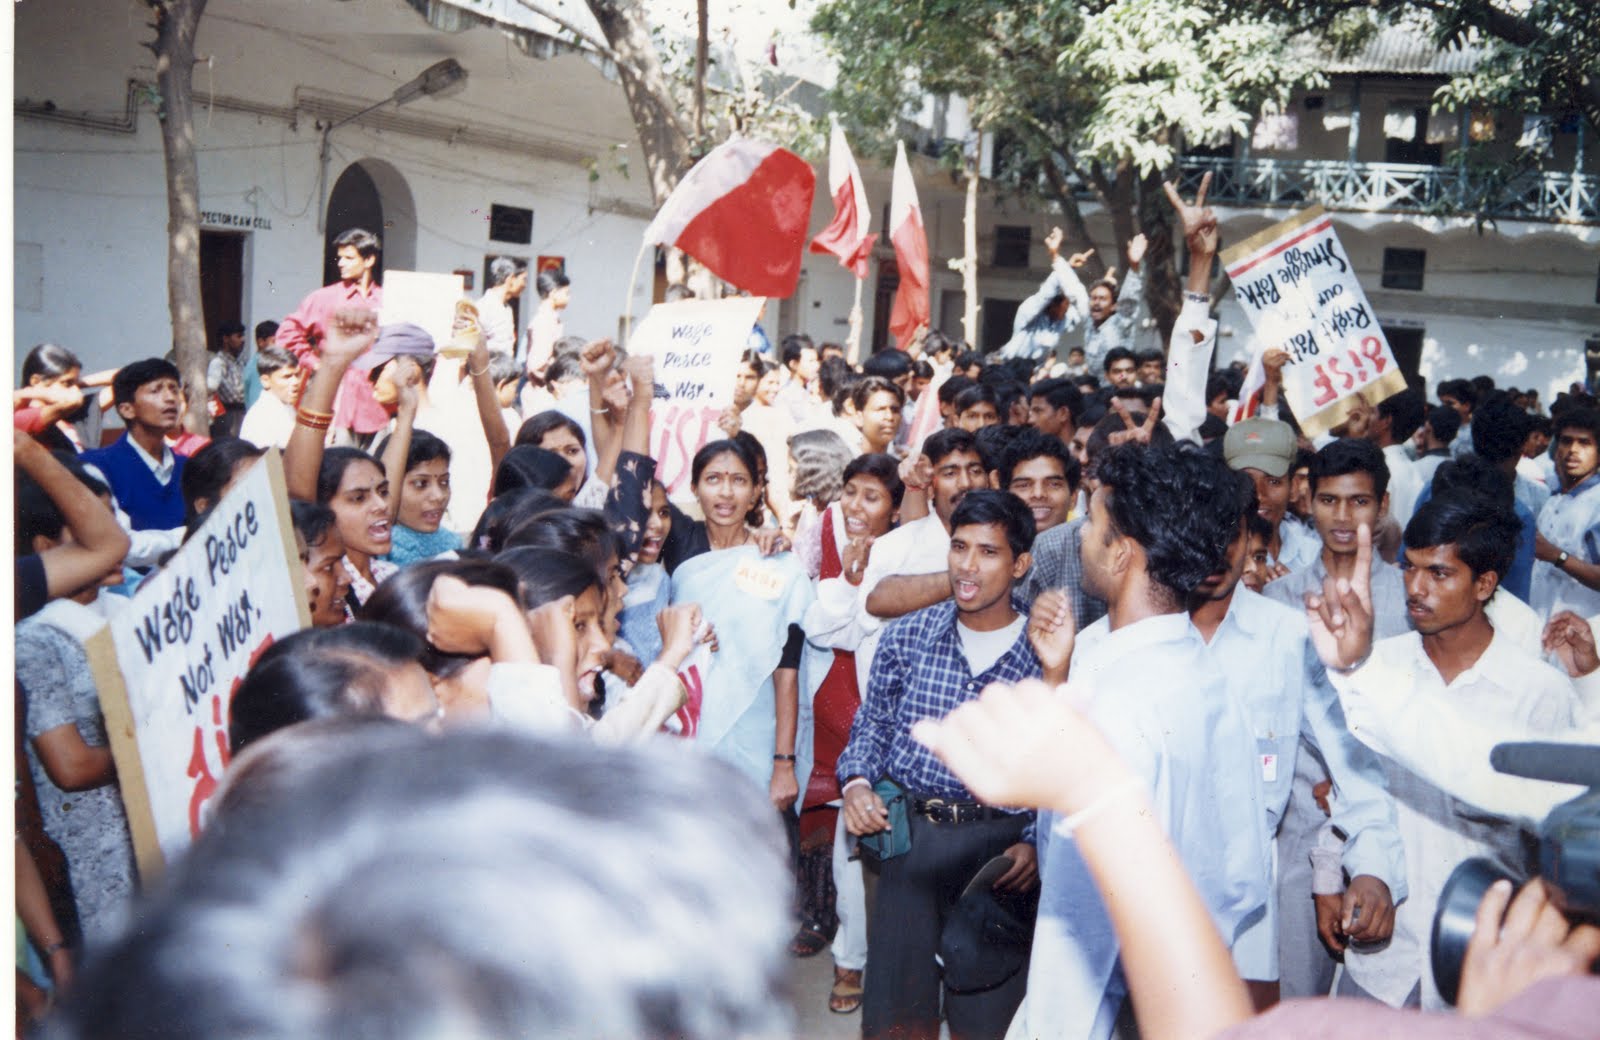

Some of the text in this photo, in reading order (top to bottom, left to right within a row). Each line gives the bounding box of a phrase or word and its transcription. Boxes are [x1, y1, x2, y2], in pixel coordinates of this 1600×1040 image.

[252, 216, 272, 231] CELL
[1277, 237, 1347, 288] Struggle
[1322, 302, 1371, 343] Right
[134, 499, 260, 665] Wage Peace
[178, 643, 217, 716] Not
